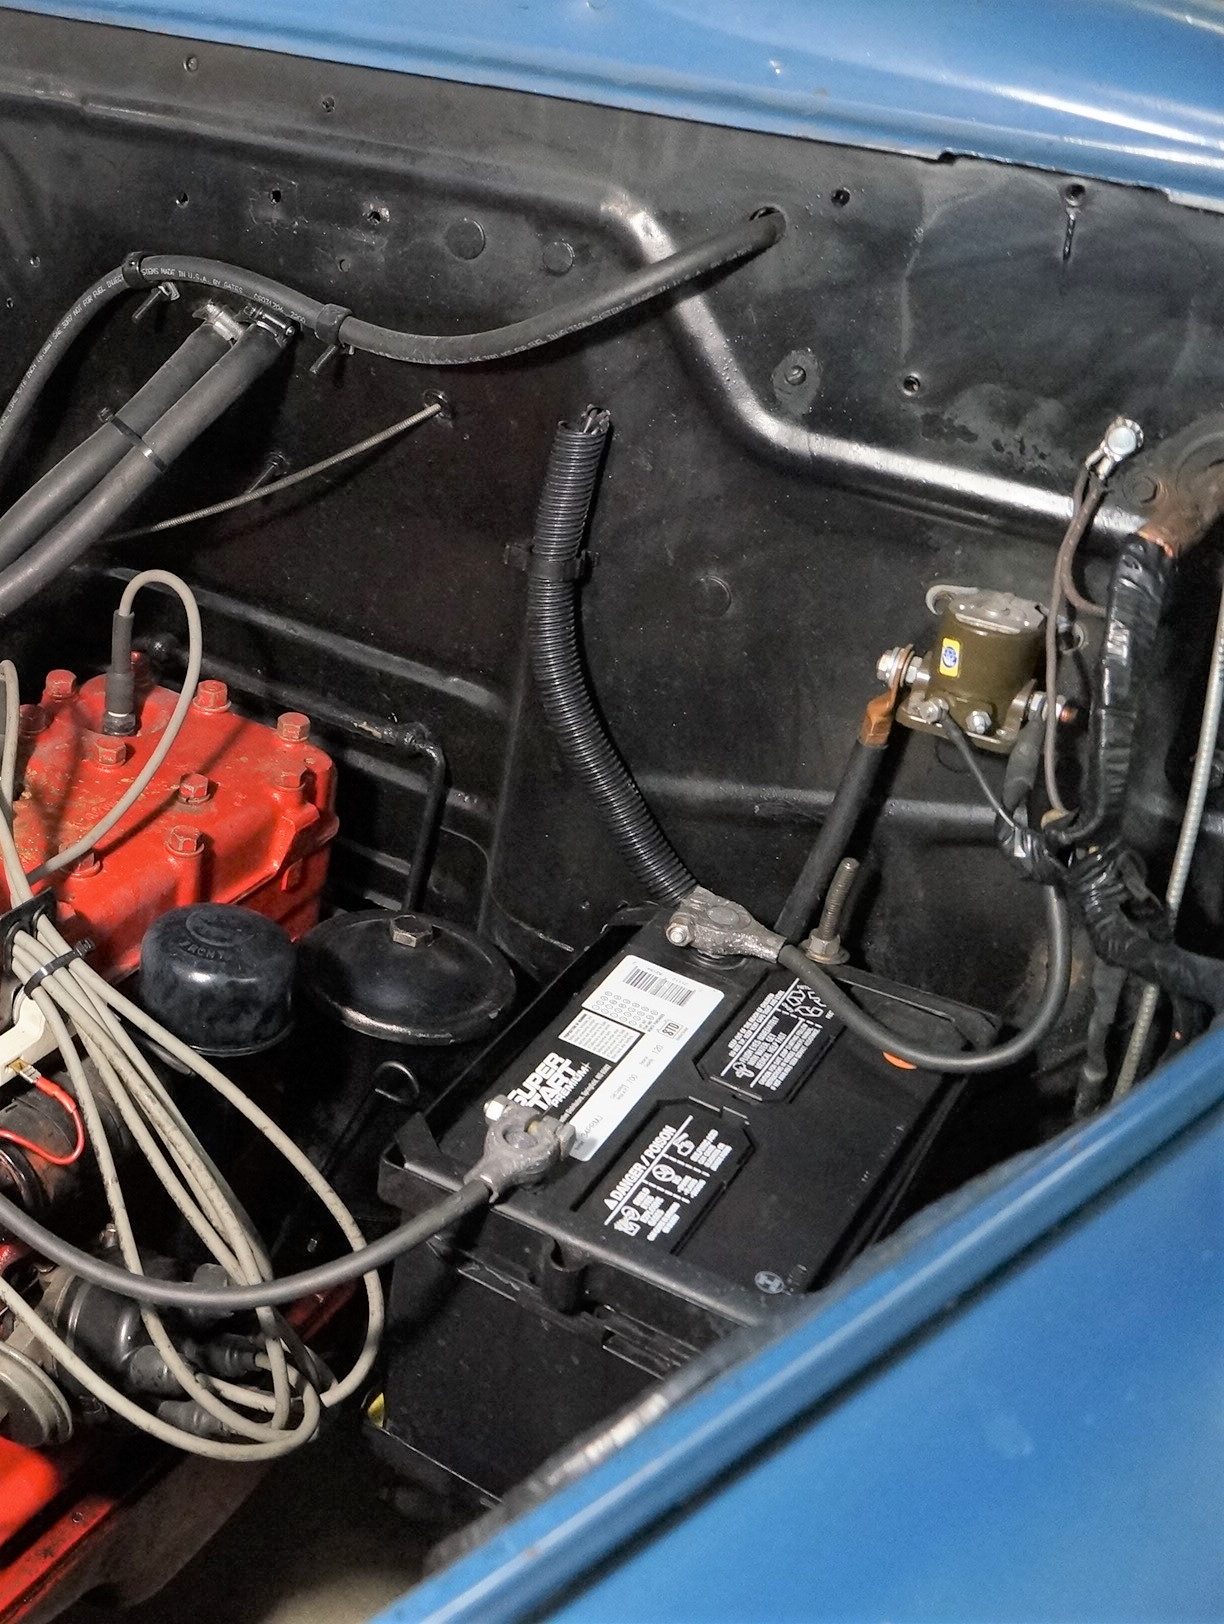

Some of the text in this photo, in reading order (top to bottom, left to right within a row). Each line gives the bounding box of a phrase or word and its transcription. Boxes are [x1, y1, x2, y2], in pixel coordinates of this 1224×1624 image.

[507, 1049, 566, 1108] SUPER
[525, 1057, 579, 1115] TART
[549, 1065, 590, 1107] PREMIUM
[609, 1161, 646, 1201] DANGER
[643, 1124, 676, 1158] POISON
